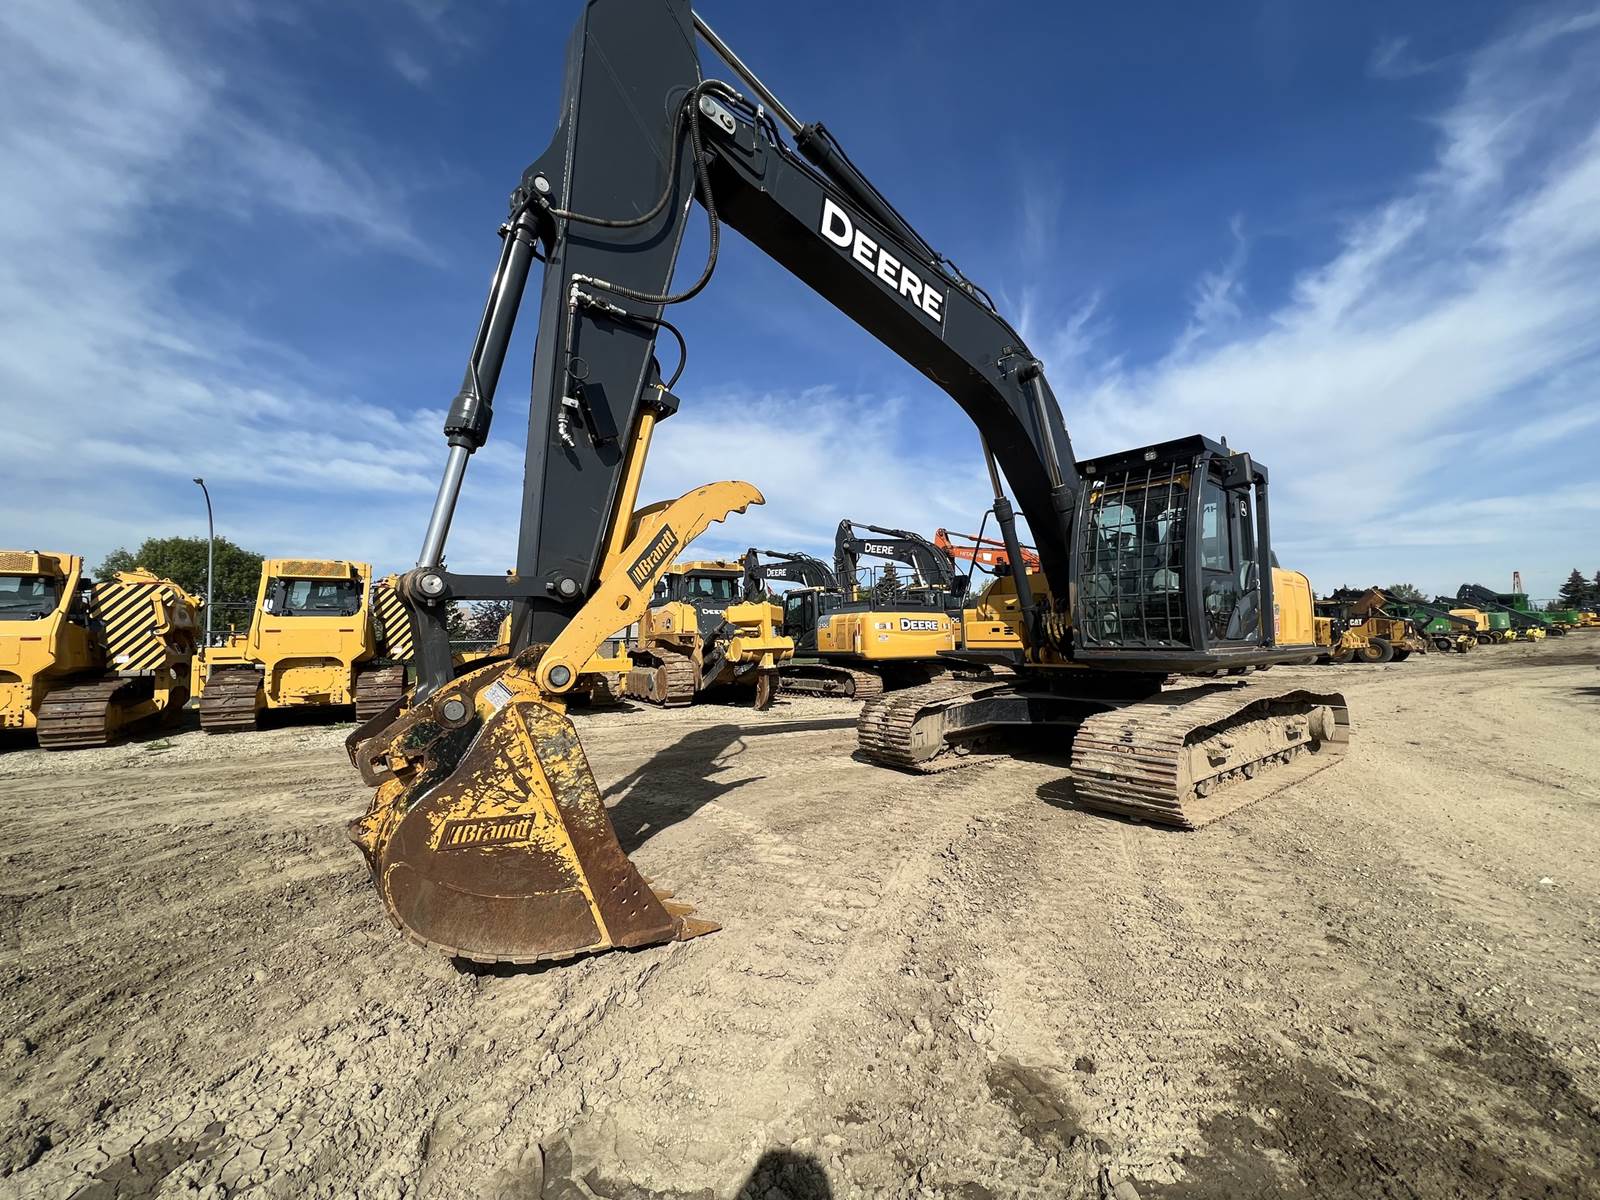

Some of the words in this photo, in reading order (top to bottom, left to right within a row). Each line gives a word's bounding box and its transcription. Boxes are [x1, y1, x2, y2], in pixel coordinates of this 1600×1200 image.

[821, 198, 943, 322] DEERE
[639, 530, 675, 576] Brandt
[864, 543, 894, 554] DEERE
[959, 551, 984, 560] HITAHI
[766, 568, 787, 577] DEERE
[900, 618, 938, 631] DEERE
[1349, 618, 1362, 626] CAT
[461, 819, 531, 844] Brandt
